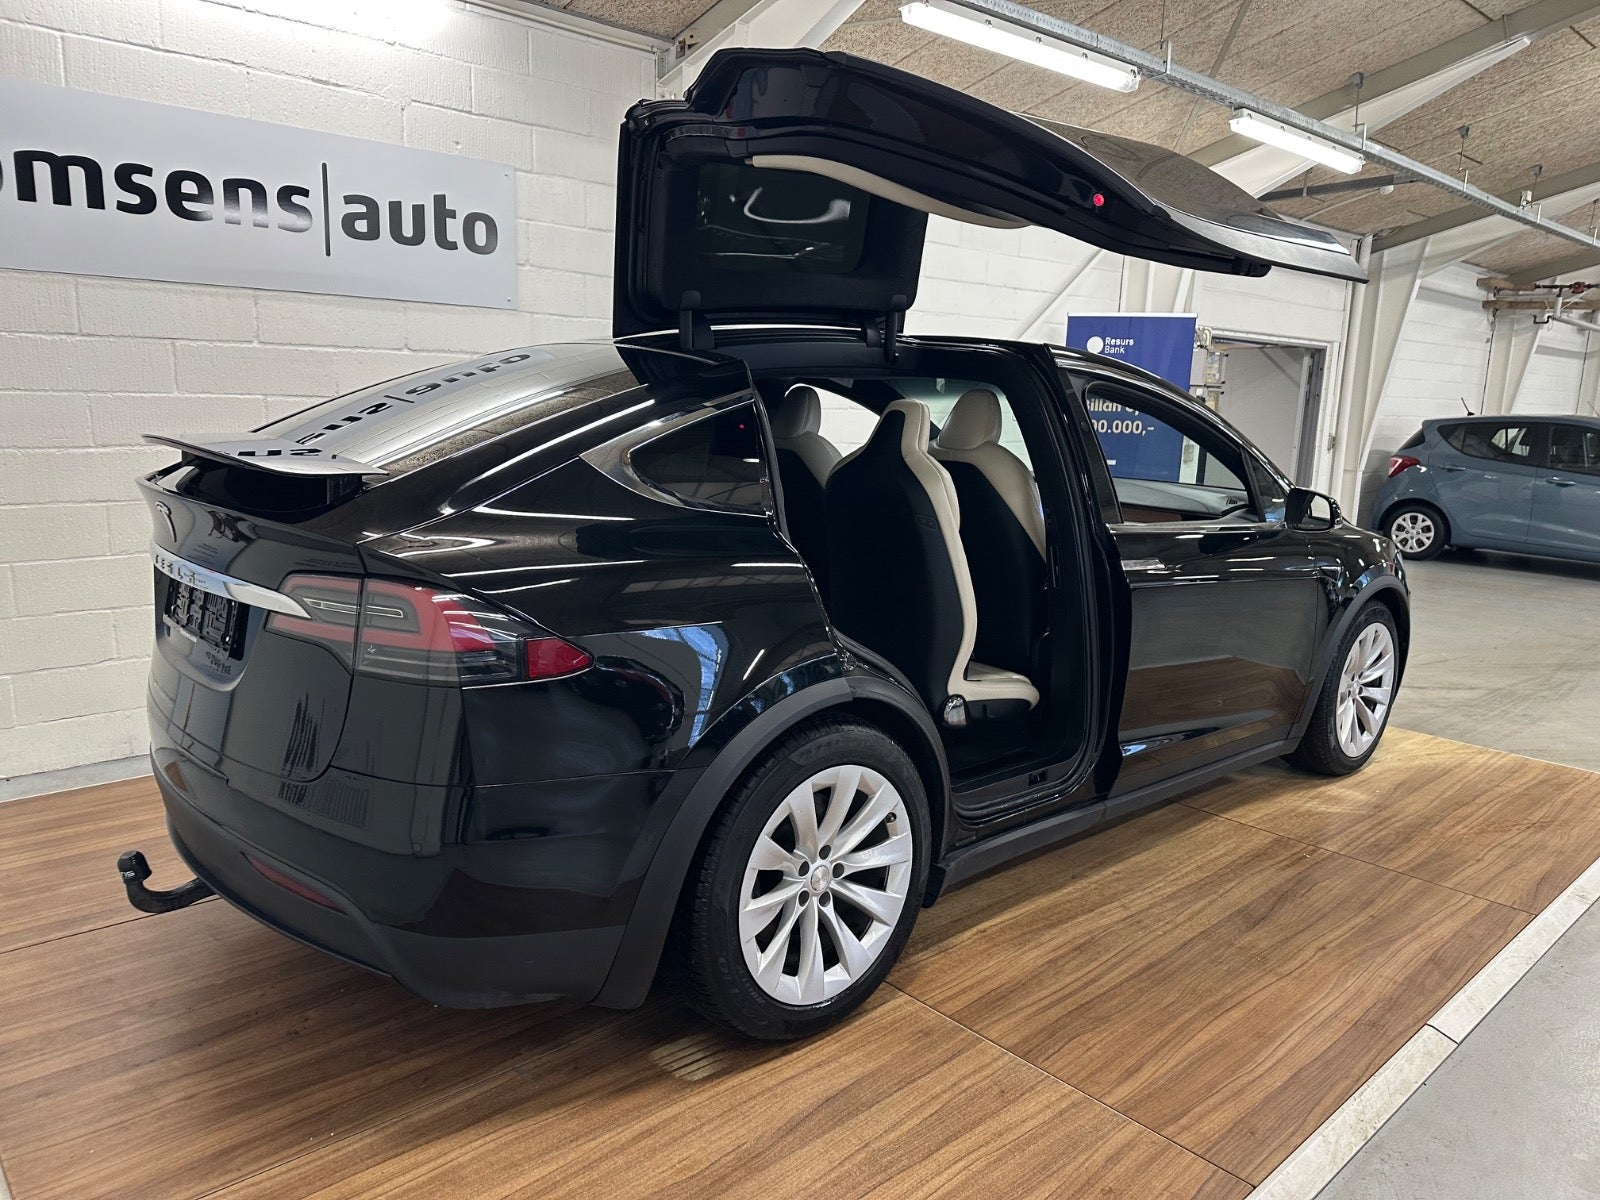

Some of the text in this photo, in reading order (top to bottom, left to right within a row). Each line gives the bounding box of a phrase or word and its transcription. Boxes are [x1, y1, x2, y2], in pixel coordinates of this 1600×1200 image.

[0, 149, 499, 256] msens auto
[1105, 337, 1134, 346] Resurs
[1104, 345, 1125, 354] Bank
